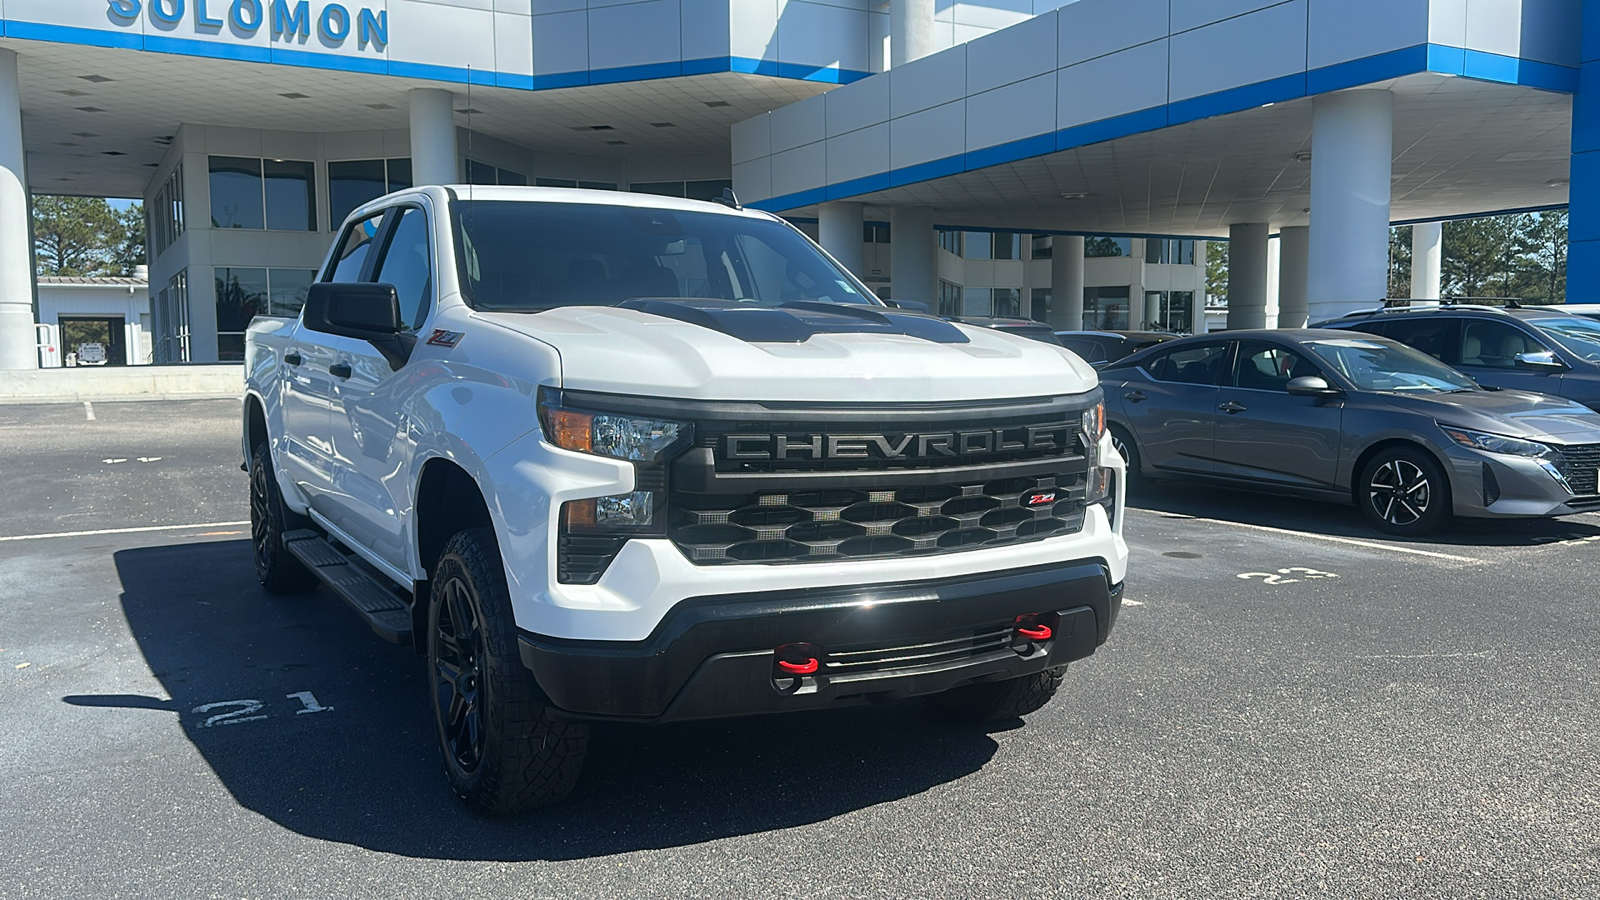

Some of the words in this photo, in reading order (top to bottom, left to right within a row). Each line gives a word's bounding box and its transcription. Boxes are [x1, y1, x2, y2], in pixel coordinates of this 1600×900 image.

[426, 328, 465, 349] Z71
[724, 420, 1080, 460] CHEVROLET
[1029, 492, 1056, 504] Z71
[192, 691, 334, 728] 21
